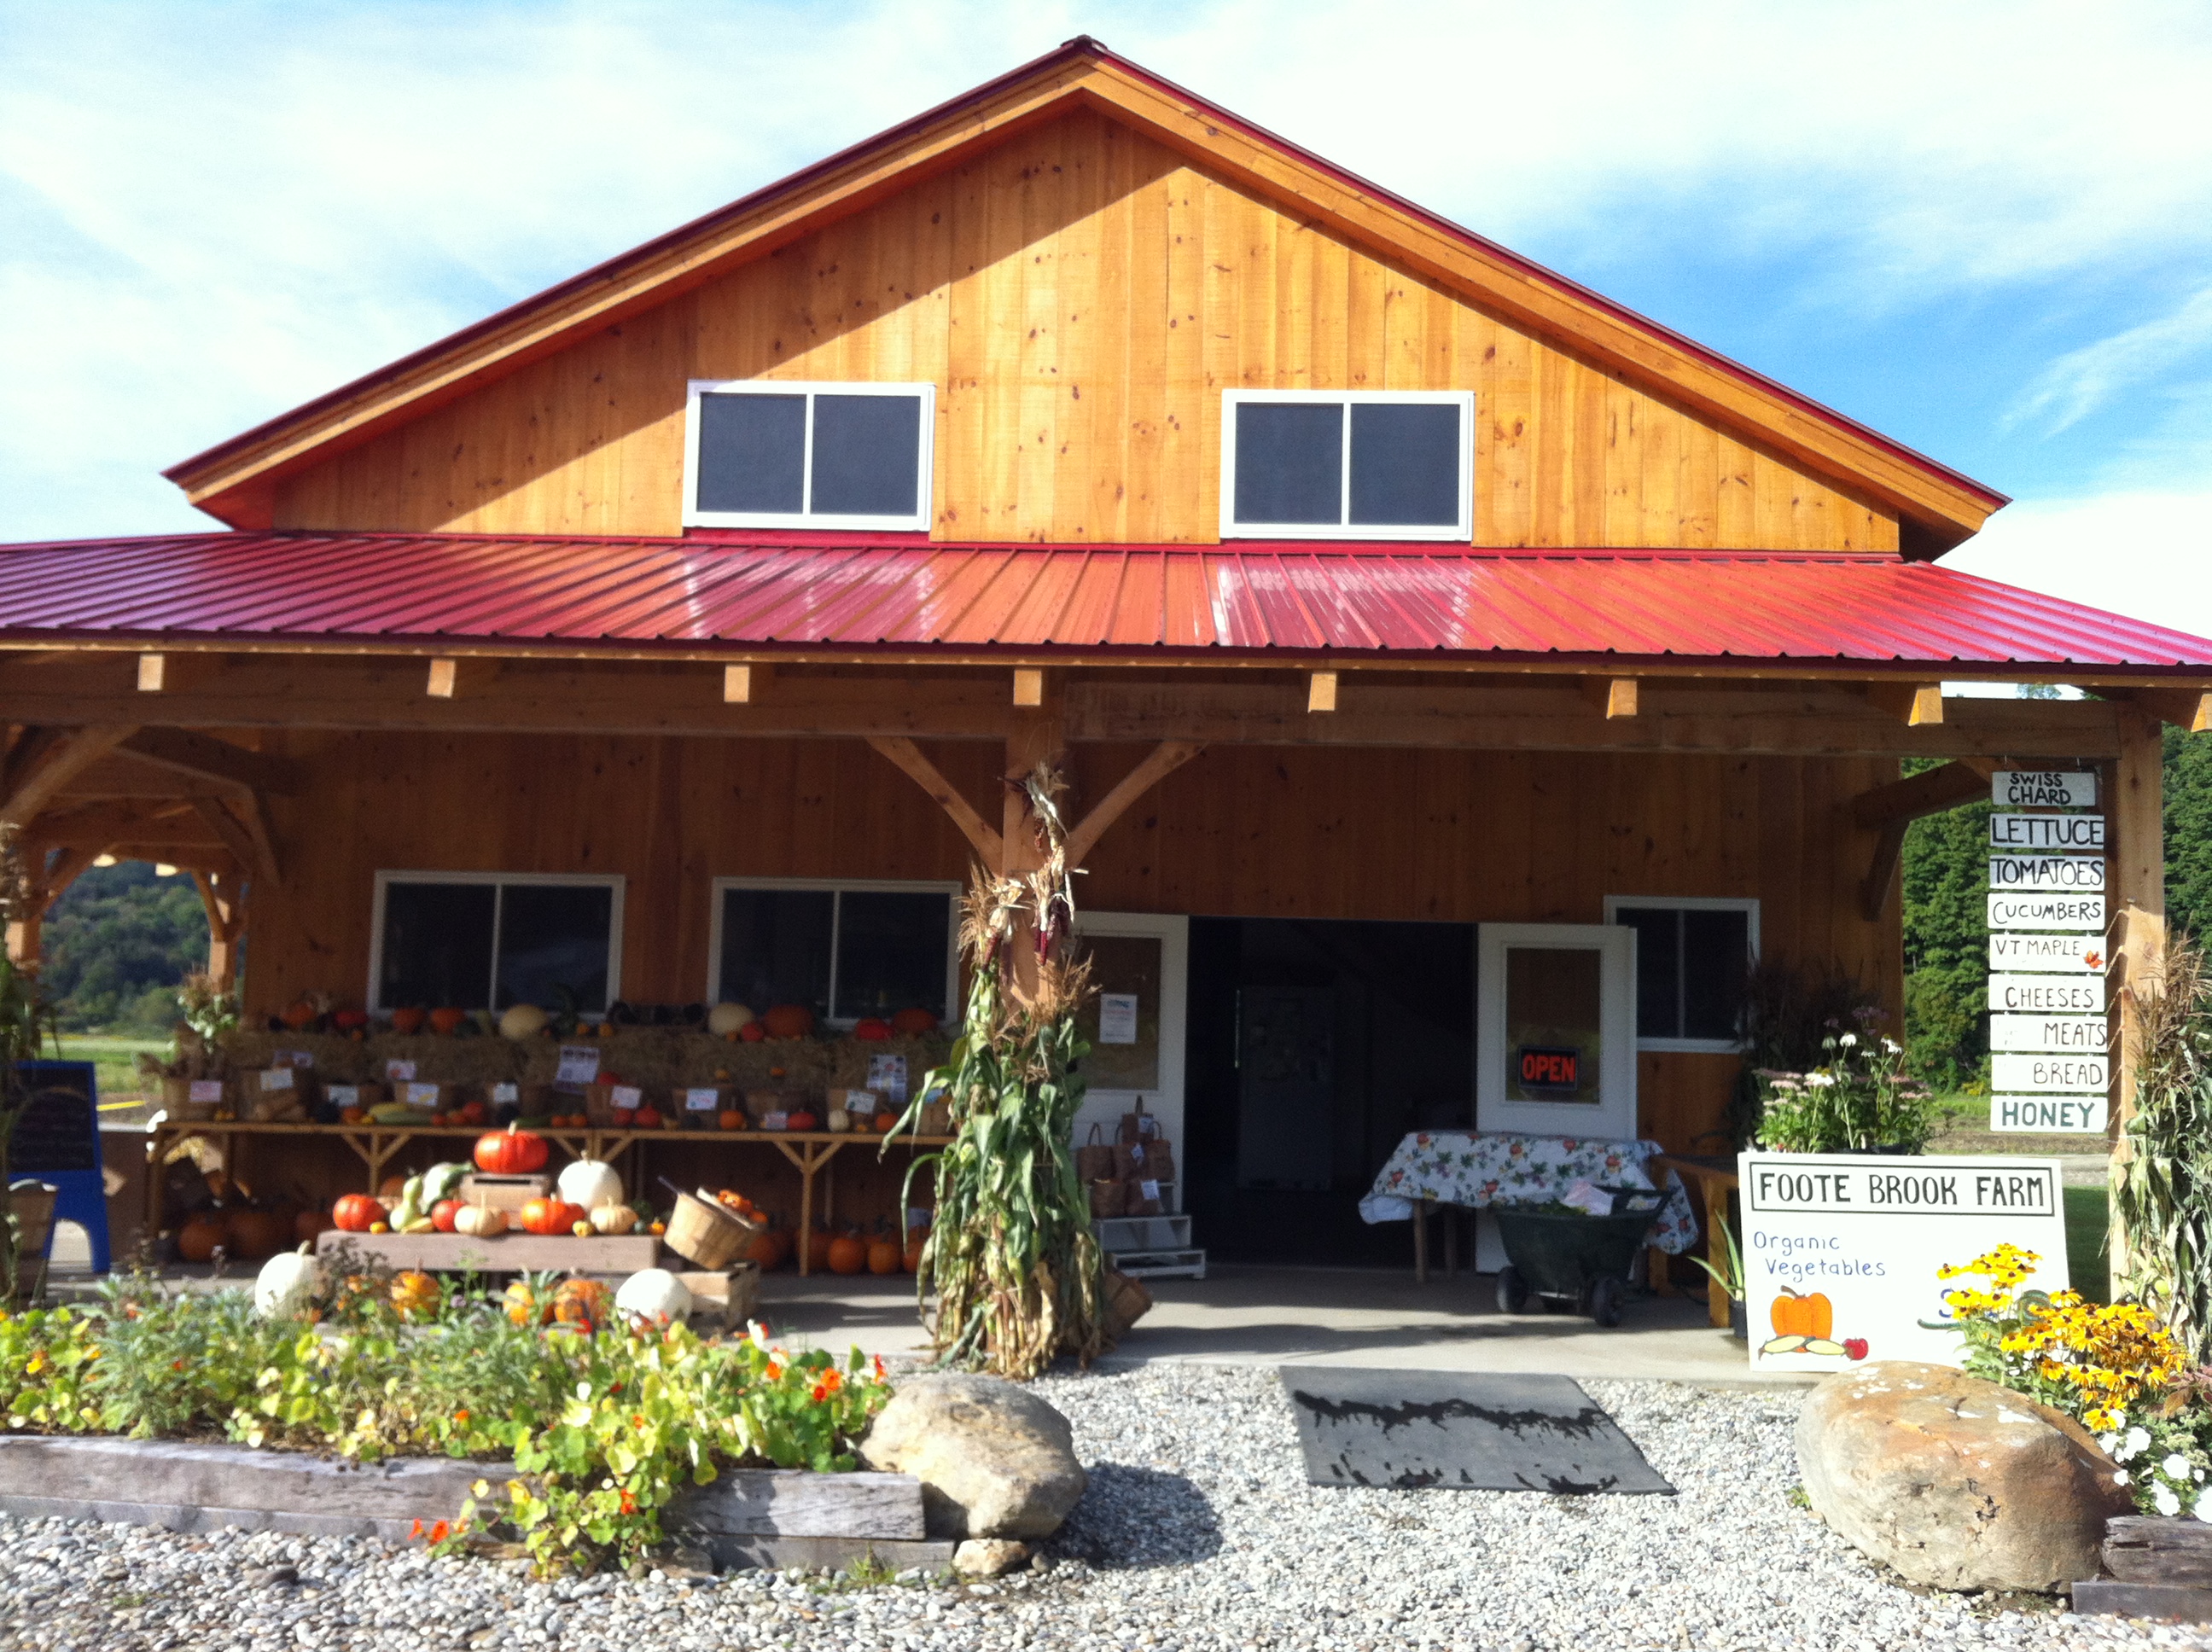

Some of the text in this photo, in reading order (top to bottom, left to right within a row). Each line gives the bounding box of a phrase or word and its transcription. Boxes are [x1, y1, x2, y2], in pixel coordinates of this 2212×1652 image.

[2010, 772, 2063, 788] SWISS
[2007, 784, 2071, 805] CHARD
[1991, 817, 2104, 846] LETTUCE
[1990, 857, 2104, 886] TOMATOES
[1993, 900, 2102, 925] CUCUMBERS
[1995, 939, 2081, 957] VT MAPLE
[2005, 986, 2094, 1009] CHEESES
[2044, 1022, 2107, 1047] MEATS
[1522, 1053, 1576, 1083] OPEN
[2034, 1062, 2103, 1085] BREAD
[2001, 1101, 2095, 1128] HONEY
[1760, 1172, 2045, 1207] FOOTE BROOK FARM
[1753, 1231, 1840, 1256] Organic
[1765, 1258, 1886, 1283] Vegetables
